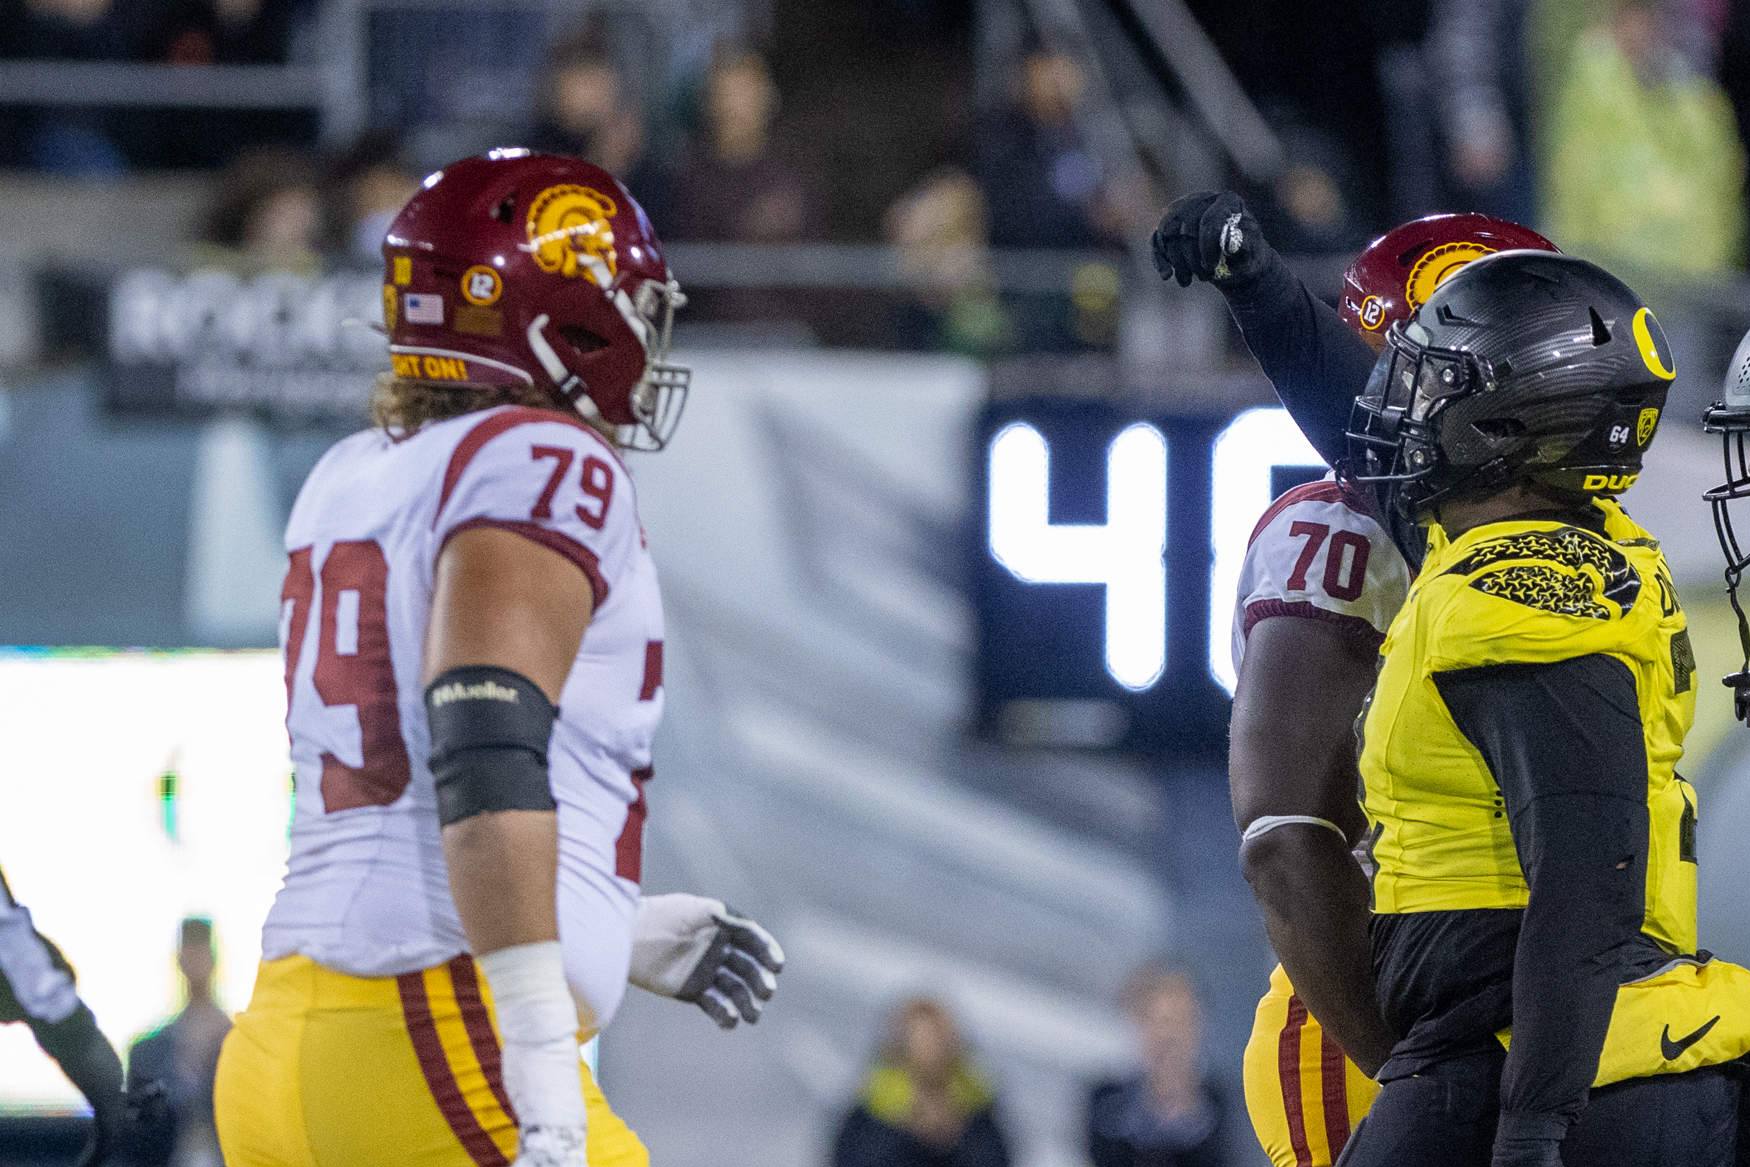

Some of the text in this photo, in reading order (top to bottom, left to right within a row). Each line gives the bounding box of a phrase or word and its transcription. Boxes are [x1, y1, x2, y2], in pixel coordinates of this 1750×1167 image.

[1363, 301, 1380, 324] 12
[1609, 425, 1630, 444] 64
[530, 443, 614, 531] 79
[1287, 520, 1371, 602] 70
[280, 538, 411, 815] 79
